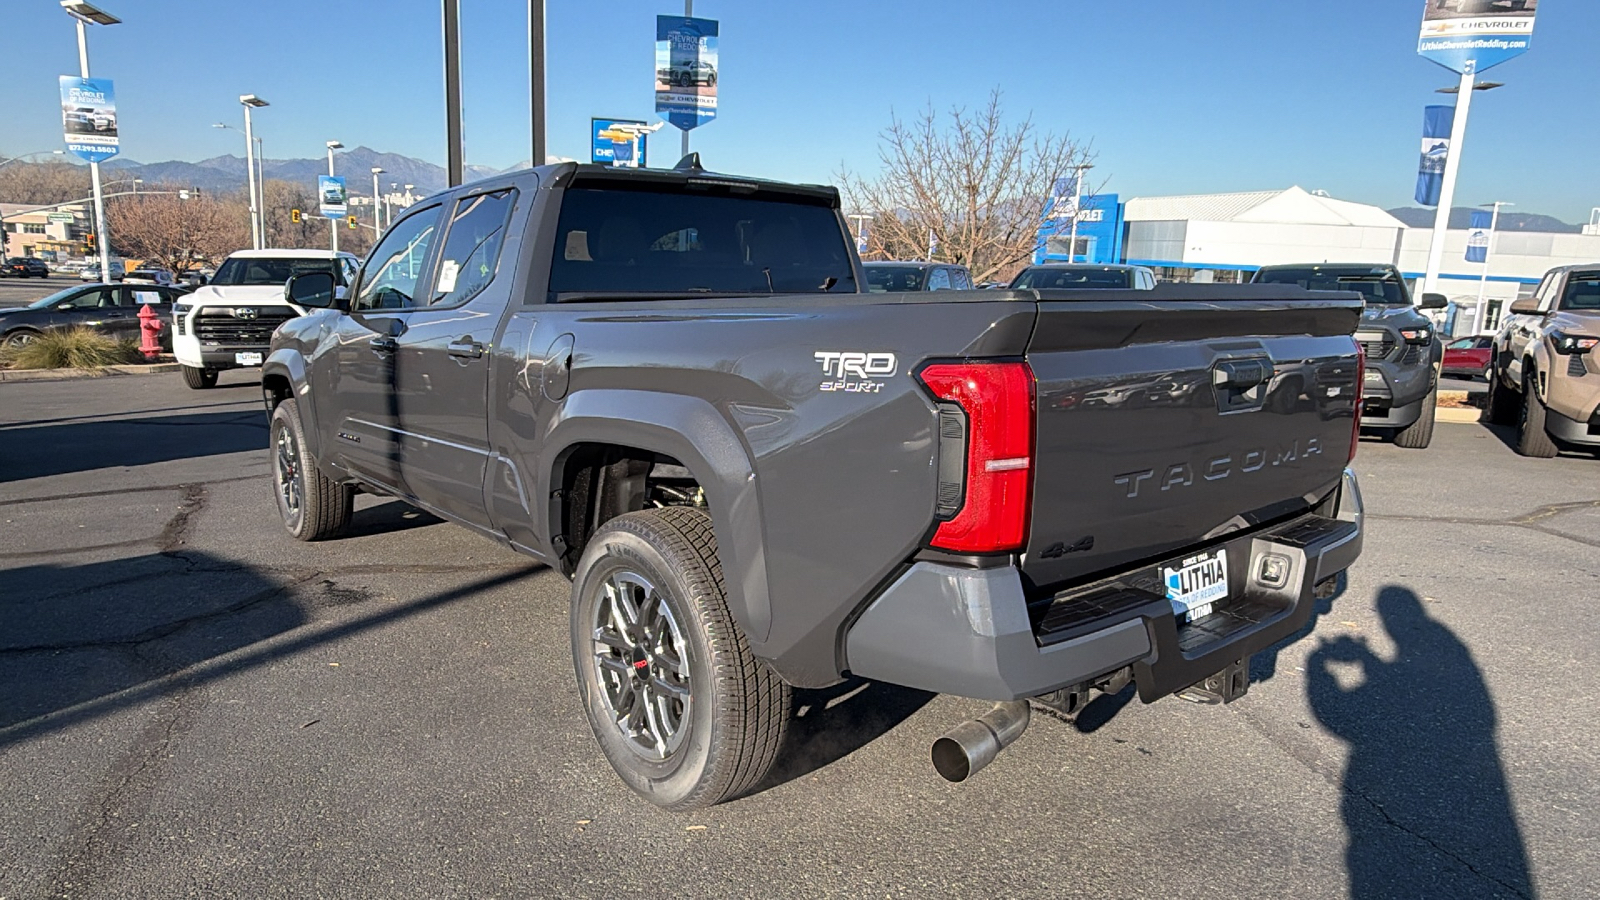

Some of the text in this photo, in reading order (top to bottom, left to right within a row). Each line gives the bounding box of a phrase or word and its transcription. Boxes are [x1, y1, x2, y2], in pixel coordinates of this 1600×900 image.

[1461, 21, 1529, 29] CHEVROLET
[668, 34, 707, 46] CHEVROLET
[1421, 39, 1526, 51] LithiaChevroletRedding.com
[69, 91, 105, 99] CHEVROLET
[677, 96, 715, 104] CHEVROLET
[814, 351, 898, 380] TRD
[820, 381, 884, 393] SPORT
[1114, 437, 1323, 498] TACOMA
[1182, 556, 1197, 567] SINCE
[1180, 560, 1224, 595] LITHIA
[1192, 592, 1199, 603] OF
[1200, 582, 1226, 601] REDDING
[1190, 602, 1212, 620] LITHIA
[634, 660, 647, 669] TRD
